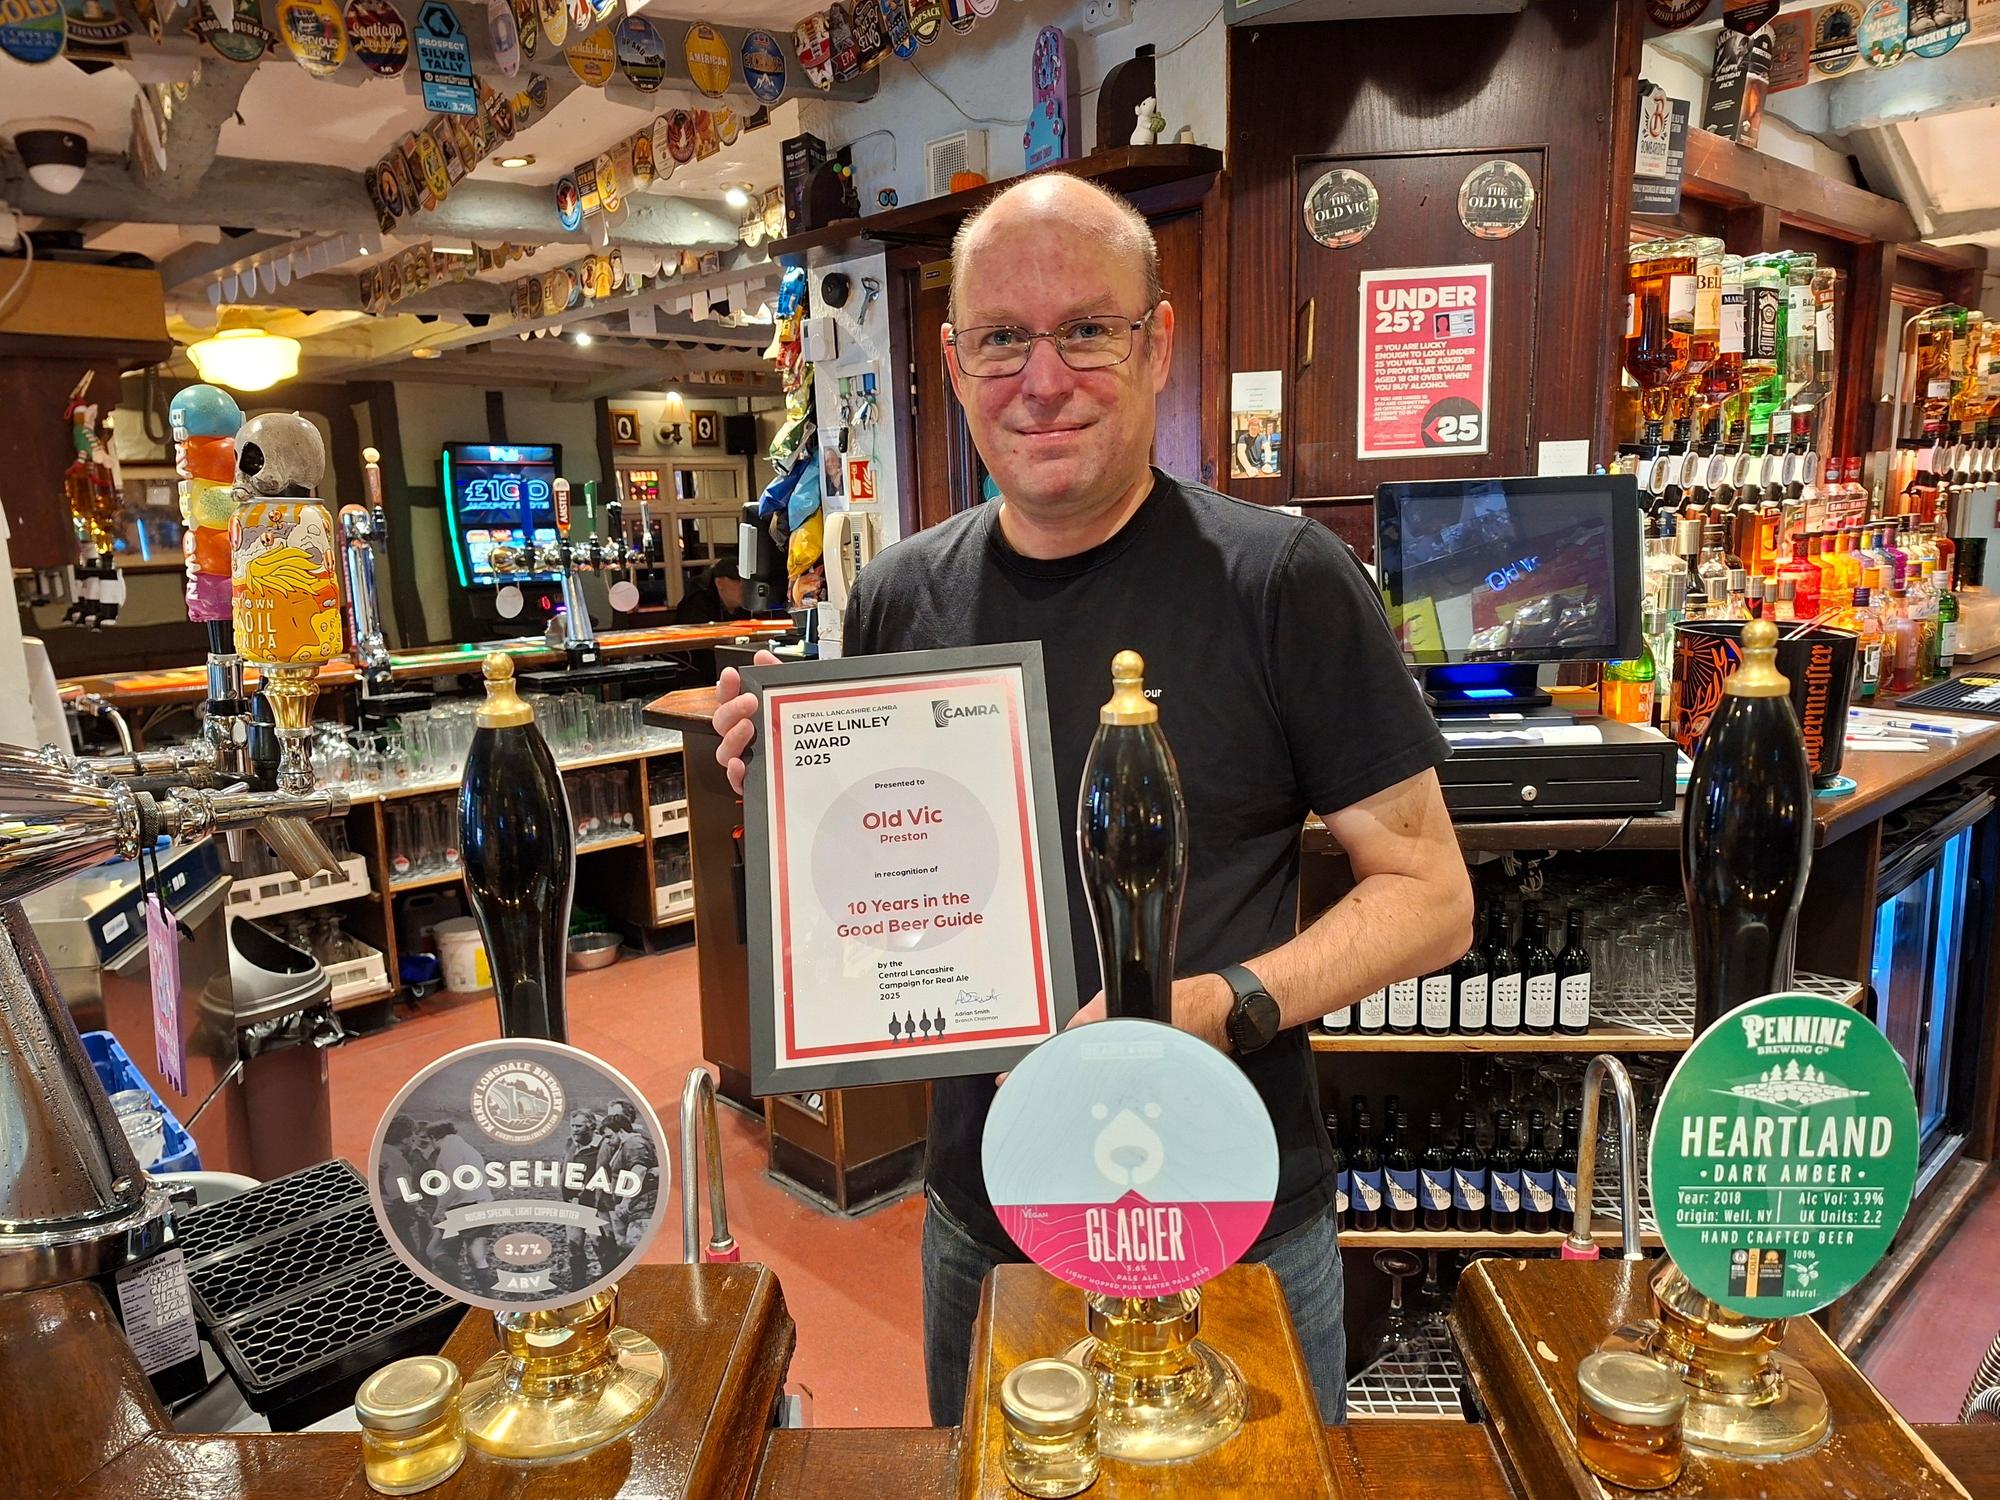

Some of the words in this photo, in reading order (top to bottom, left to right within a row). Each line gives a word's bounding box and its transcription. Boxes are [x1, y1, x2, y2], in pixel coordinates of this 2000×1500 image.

[909, 6, 941, 29] HOPSACK
[1864, 17, 1898, 33] White
[199, 19, 269, 41] MOOOUSE'S
[352, 22, 402, 42] Santiago
[1874, 25, 1907, 39] Rabb
[1905, 28, 1950, 51] CLOCKIN'
[1950, 22, 1967, 38] OFF
[419, 37, 464, 50] PROSPECT
[421, 47, 466, 62] SILVER
[689, 51, 728, 67] AMERICAN
[841, 50, 856, 66] EPA
[425, 58, 463, 72] TALLY
[1716, 71, 1741, 82] BIRTHDAY
[451, 102, 474, 112] 3.7%
[1640, 140, 1666, 157] BOMBARDIER
[1487, 186, 1508, 196] THE
[1329, 194, 1351, 207] THE
[1469, 197, 1496, 208] OLD
[1498, 198, 1523, 209] VIC
[1315, 207, 1344, 221] OLD
[1346, 201, 1370, 216] VIC
[1375, 285, 1477, 311] UNDER
[1375, 310, 1425, 333] 25?
[1420, 341, 1447, 349] LUCKY
[1375, 351, 1409, 359] ENOUGH
[1437, 356, 1464, 364] ASKED
[1375, 375, 1396, 383] AGED
[1420, 373, 1443, 381] OVER
[1387, 367, 1414, 375] PROVE
[558, 490, 569, 524] AMSTEL
[245, 611, 276, 633] OIL
[792, 711, 825, 719] CENTRAL
[826, 707, 871, 717] LANCASHIRE
[872, 704, 898, 712] CAMRA
[942, 704, 1000, 720] CAMRA
[793, 721, 834, 735] DAVE
[837, 715, 890, 731] LINLEY
[794, 735, 851, 751] AWARD
[795, 753, 832, 767] 2025
[874, 780, 914, 789] Presented
[863, 810, 902, 830] Old
[907, 806, 943, 825] Vic
[880, 832, 928, 844] Preston
[874, 871, 882, 879] in
[883, 867, 929, 878] recognition
[848, 901, 867, 915] 10
[871, 897, 919, 913] Years
[923, 894, 938, 908] in
[940, 892, 970, 906] the
[837, 921, 884, 938] Good
[889, 918, 930, 933] Beer
[934, 912, 984, 928] Guide
[877, 962, 888, 970] by
[889, 960, 903, 968] the
[878, 970, 908, 980] Central
[910, 965, 955, 976] Lancashire
[879, 979, 921, 991] Campaign
[922, 977, 934, 986] for
[936, 976, 954, 985] Real
[956, 975, 970, 983] Ale
[880, 992, 901, 1001] 2025
[1741, 1014, 1852, 1049] PENNINE
[1757, 1044, 1812, 1056] BREWING
[477, 1062, 532, 1092] LONSDALE
[533, 1066, 563, 1113] BREWERY
[473, 1092, 495, 1133] KIRKBY
[1681, 1115, 1893, 1159] HEARTLAND
[1714, 1164, 1767, 1183] DARK
[1780, 1163, 1851, 1183] AMBER
[396, 1160, 645, 1204] LOOSEHEAD
[1677, 1191, 1709, 1206] Year:
[1713, 1191, 1742, 1205] 2018
[1798, 1192, 1818, 1205] Alc
[1824, 1192, 1848, 1206] Vol:
[1852, 1192, 1884, 1206] 3.9%
[486, 1207, 514, 1219] SPECIAL,
[515, 1207, 532, 1217] LIGHT
[533, 1207, 558, 1217] COPPER
[559, 1209, 580, 1220] BITTER
[1022, 1207, 1048, 1220] VEGAN
[1676, 1209, 1719, 1225] Origin:
[1757, 1210, 1773, 1223] NY
[1799, 1210, 1815, 1223] UK
[1820, 1210, 1858, 1224] Units:
[1863, 1210, 1882, 1224] 2.2
[1086, 1207, 1186, 1262] GLACIER
[1701, 1230, 1738, 1244] HAND
[1747, 1230, 1809, 1244] CRAFTED
[1818, 1231, 1854, 1245] BEER
[504, 1242, 542, 1256] 3.7%
[1793, 1250, 1816, 1259] 100%
[132, 1257, 166, 1274] ANGRAM
[507, 1276, 541, 1290] ABV
[1065, 1268, 1088, 1281] LIGHT
[1089, 1278, 1120, 1290] HOPPED
[1145, 1282, 1170, 1290] WATER
[1172, 1276, 1190, 1286] PALE
[1192, 1266, 1210, 1279] BEER
[1116, 1274, 1139, 1282] PALE
[1141, 1273, 1159, 1281] ALE
[1786, 1289, 1817, 1298] natural
